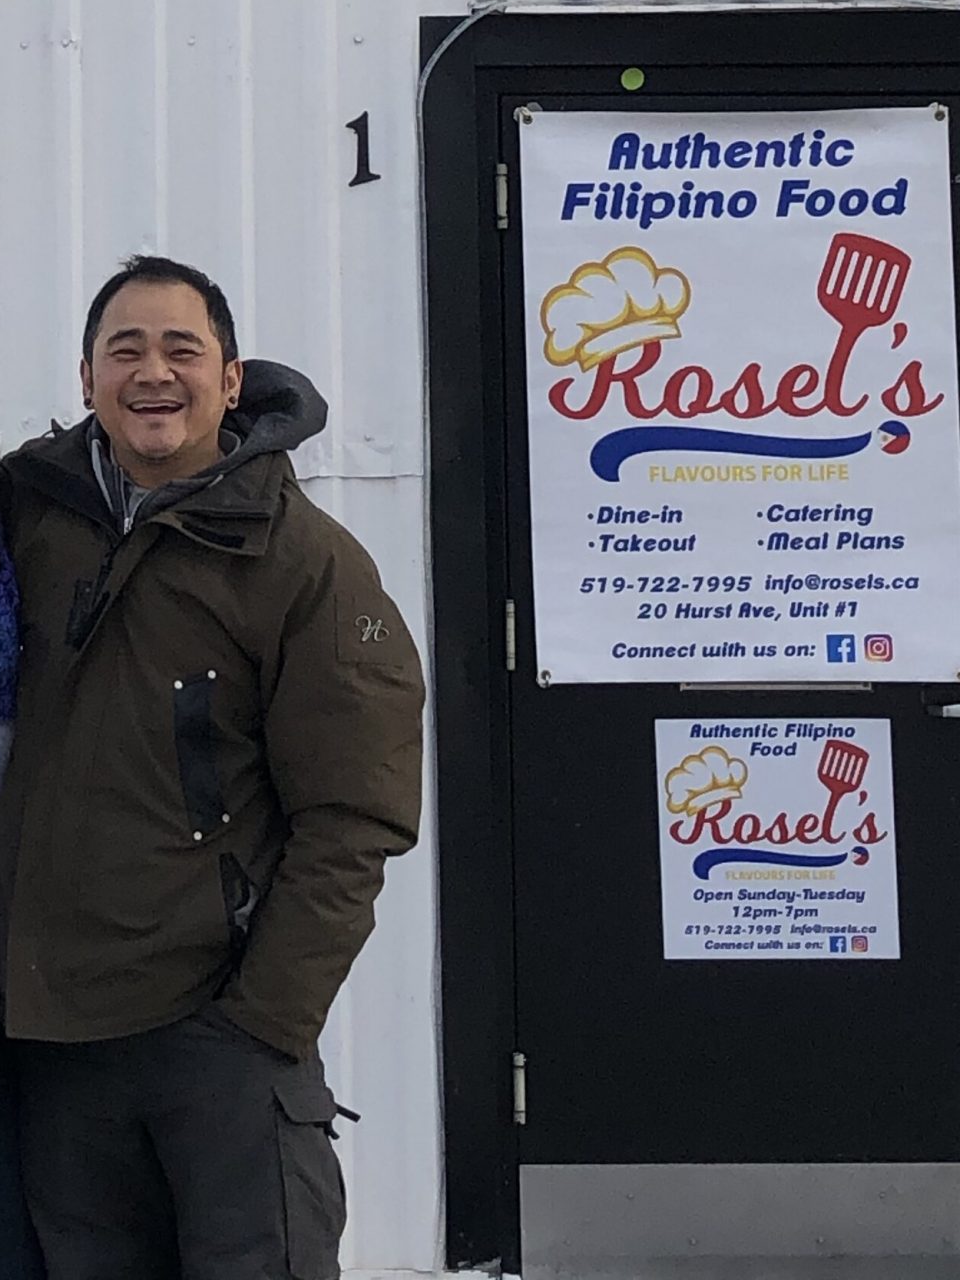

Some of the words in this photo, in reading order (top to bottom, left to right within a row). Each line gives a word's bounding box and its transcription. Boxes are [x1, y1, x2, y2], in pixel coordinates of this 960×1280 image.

[345, 110, 381, 187] 1
[609, 130, 855, 170] Authentic
[561, 181, 757, 229] Filipino
[776, 178, 909, 218] Food
[548, 320, 945, 420] Rosel's
[649, 465, 756, 482] FLAVOURS
[762, 464, 802, 481] FOR
[808, 464, 849, 481] LIFE
[597, 506, 683, 524] Dine-in
[766, 504, 873, 526] Catering
[600, 535, 696, 552] Takeout
[767, 533, 828, 550] Meal
[836, 532, 905, 550] Plans
[579, 577, 752, 593] 519-722-7995
[764, 575, 920, 594] info@rosels.ca
[637, 604, 667, 620] 20
[675, 604, 732, 619] Hurst
[739, 603, 782, 621] Ave,
[790, 602, 829, 618] Unit
[612, 643, 696, 659] Connect
[702, 642, 746, 658] with
[753, 645, 777, 658] us
[784, 643, 816, 658] on:
[690, 724, 778, 738] Authentic
[785, 723, 856, 741] Filipino
[750, 742, 797, 756] Food
[669, 790, 888, 845] Rosel's
[726, 871, 785, 880] FLAVOURS
[787, 871, 810, 880] FOR
[813, 871, 836, 880] LIFE
[693, 889, 733, 902] Open
[737, 889, 866, 903] Sunday-Tuesday
[685, 925, 781, 935] 519-722-7995
[704, 940, 754, 950] Connect
[757, 940, 783, 950] with
[787, 942, 801, 950] us
